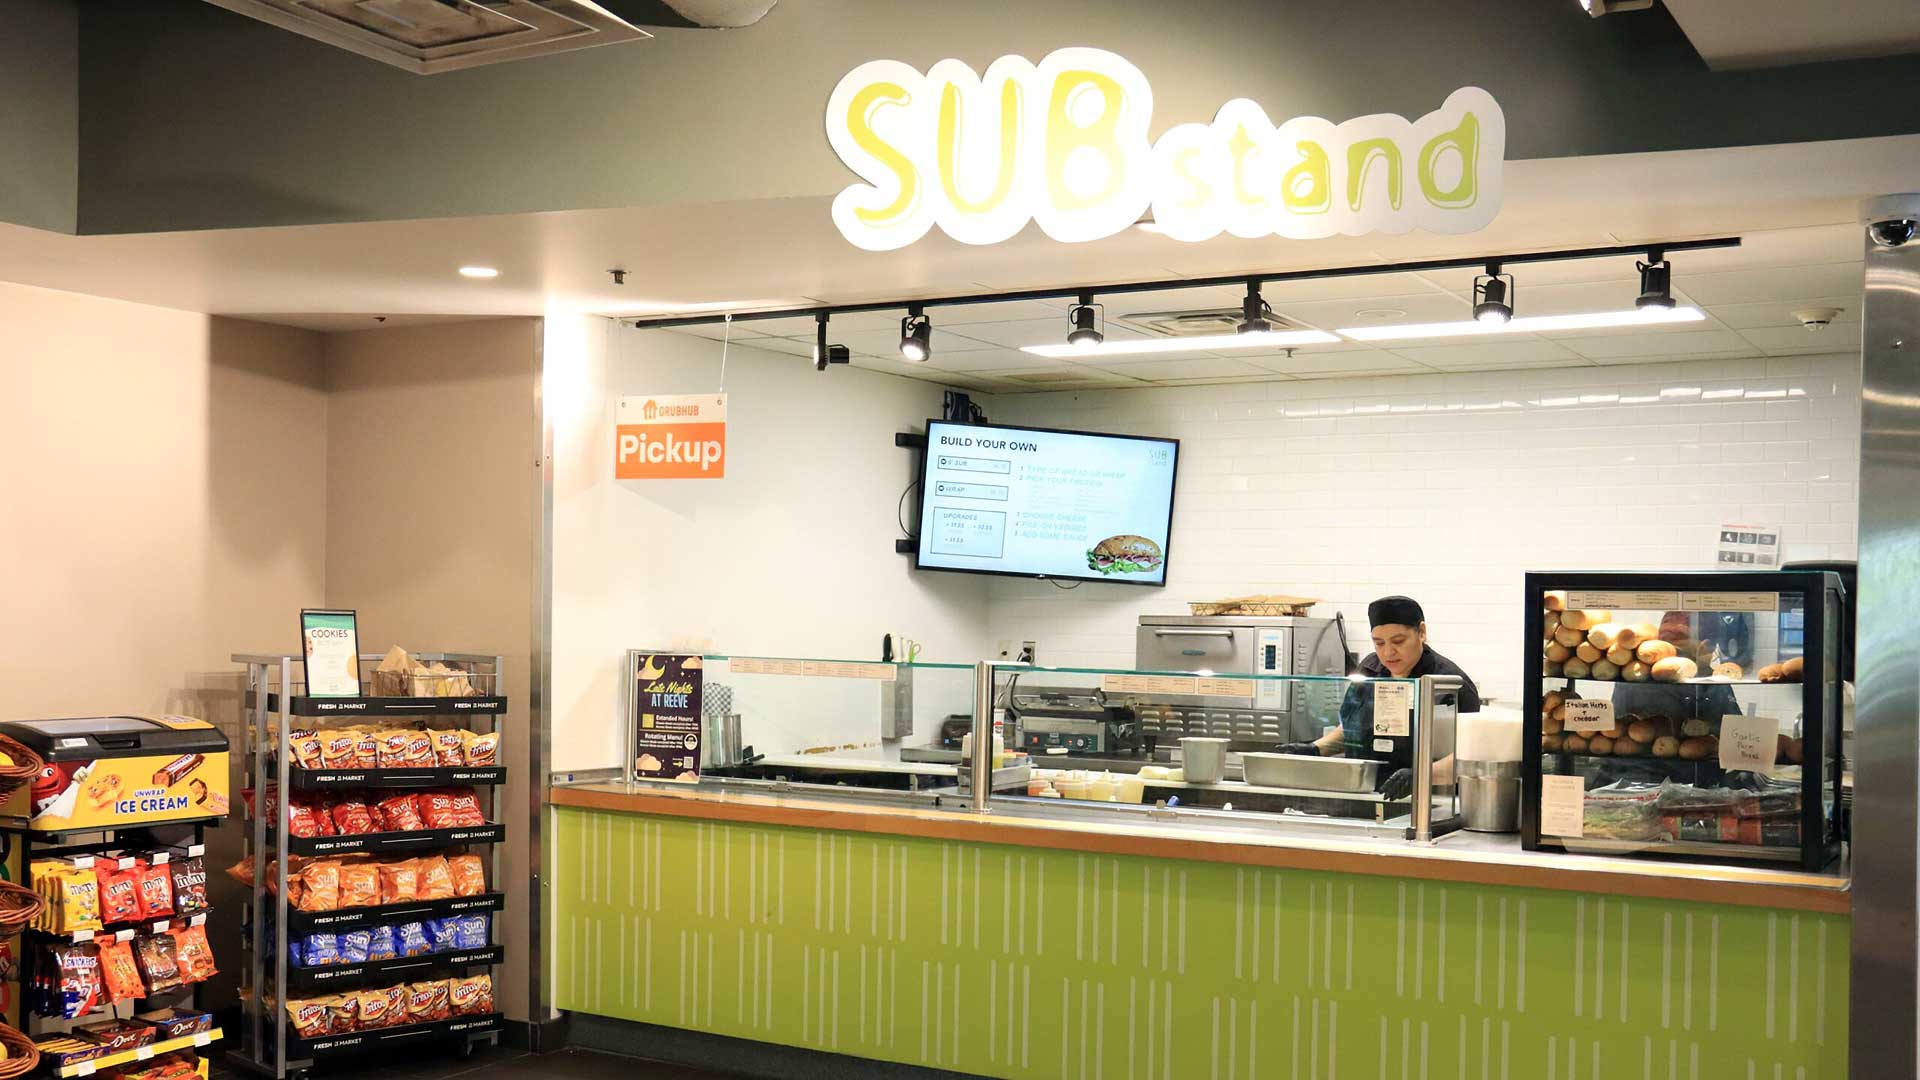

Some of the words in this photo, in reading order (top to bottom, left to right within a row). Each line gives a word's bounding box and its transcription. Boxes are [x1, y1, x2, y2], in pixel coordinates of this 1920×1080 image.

[846, 69, 1130, 229] SUB
[1174, 112, 1480, 215] stand
[659, 405, 699, 417] GRUBHUB
[940, 435, 972, 447] BUILD
[976, 439, 1006, 449] YOUR
[1009, 441, 1037, 452] OWN
[619, 432, 722, 471] Pickup
[311, 629, 348, 638] COOKIES
[643, 681, 665, 693] Late
[665, 681, 693, 694] Nights
[651, 693, 661, 707] AT
[664, 694, 688, 708] REEVE
[645, 733, 667, 741] Rotating
[134, 788, 165, 798] UNWRAP
[115, 801, 136, 814] ICE
[141, 797, 188, 812] CREAM
[341, 840, 363, 848] MARKET
[314, 917, 333, 925] FRESH
[464, 921, 485, 935] Sun
[345, 933, 369, 947] Sun
[436, 928, 455, 943] Sun
[66, 957, 96, 968] SNICKERS
[473, 953, 494, 961] MARKET
[455, 983, 479, 999] Fritos
[172, 1021, 194, 1034] Dove
[472, 1019, 494, 1028] MARKET
[111, 1033, 136, 1047] Dove
[313, 1042, 332, 1050] FRESH
[339, 1038, 362, 1046] MARKET
